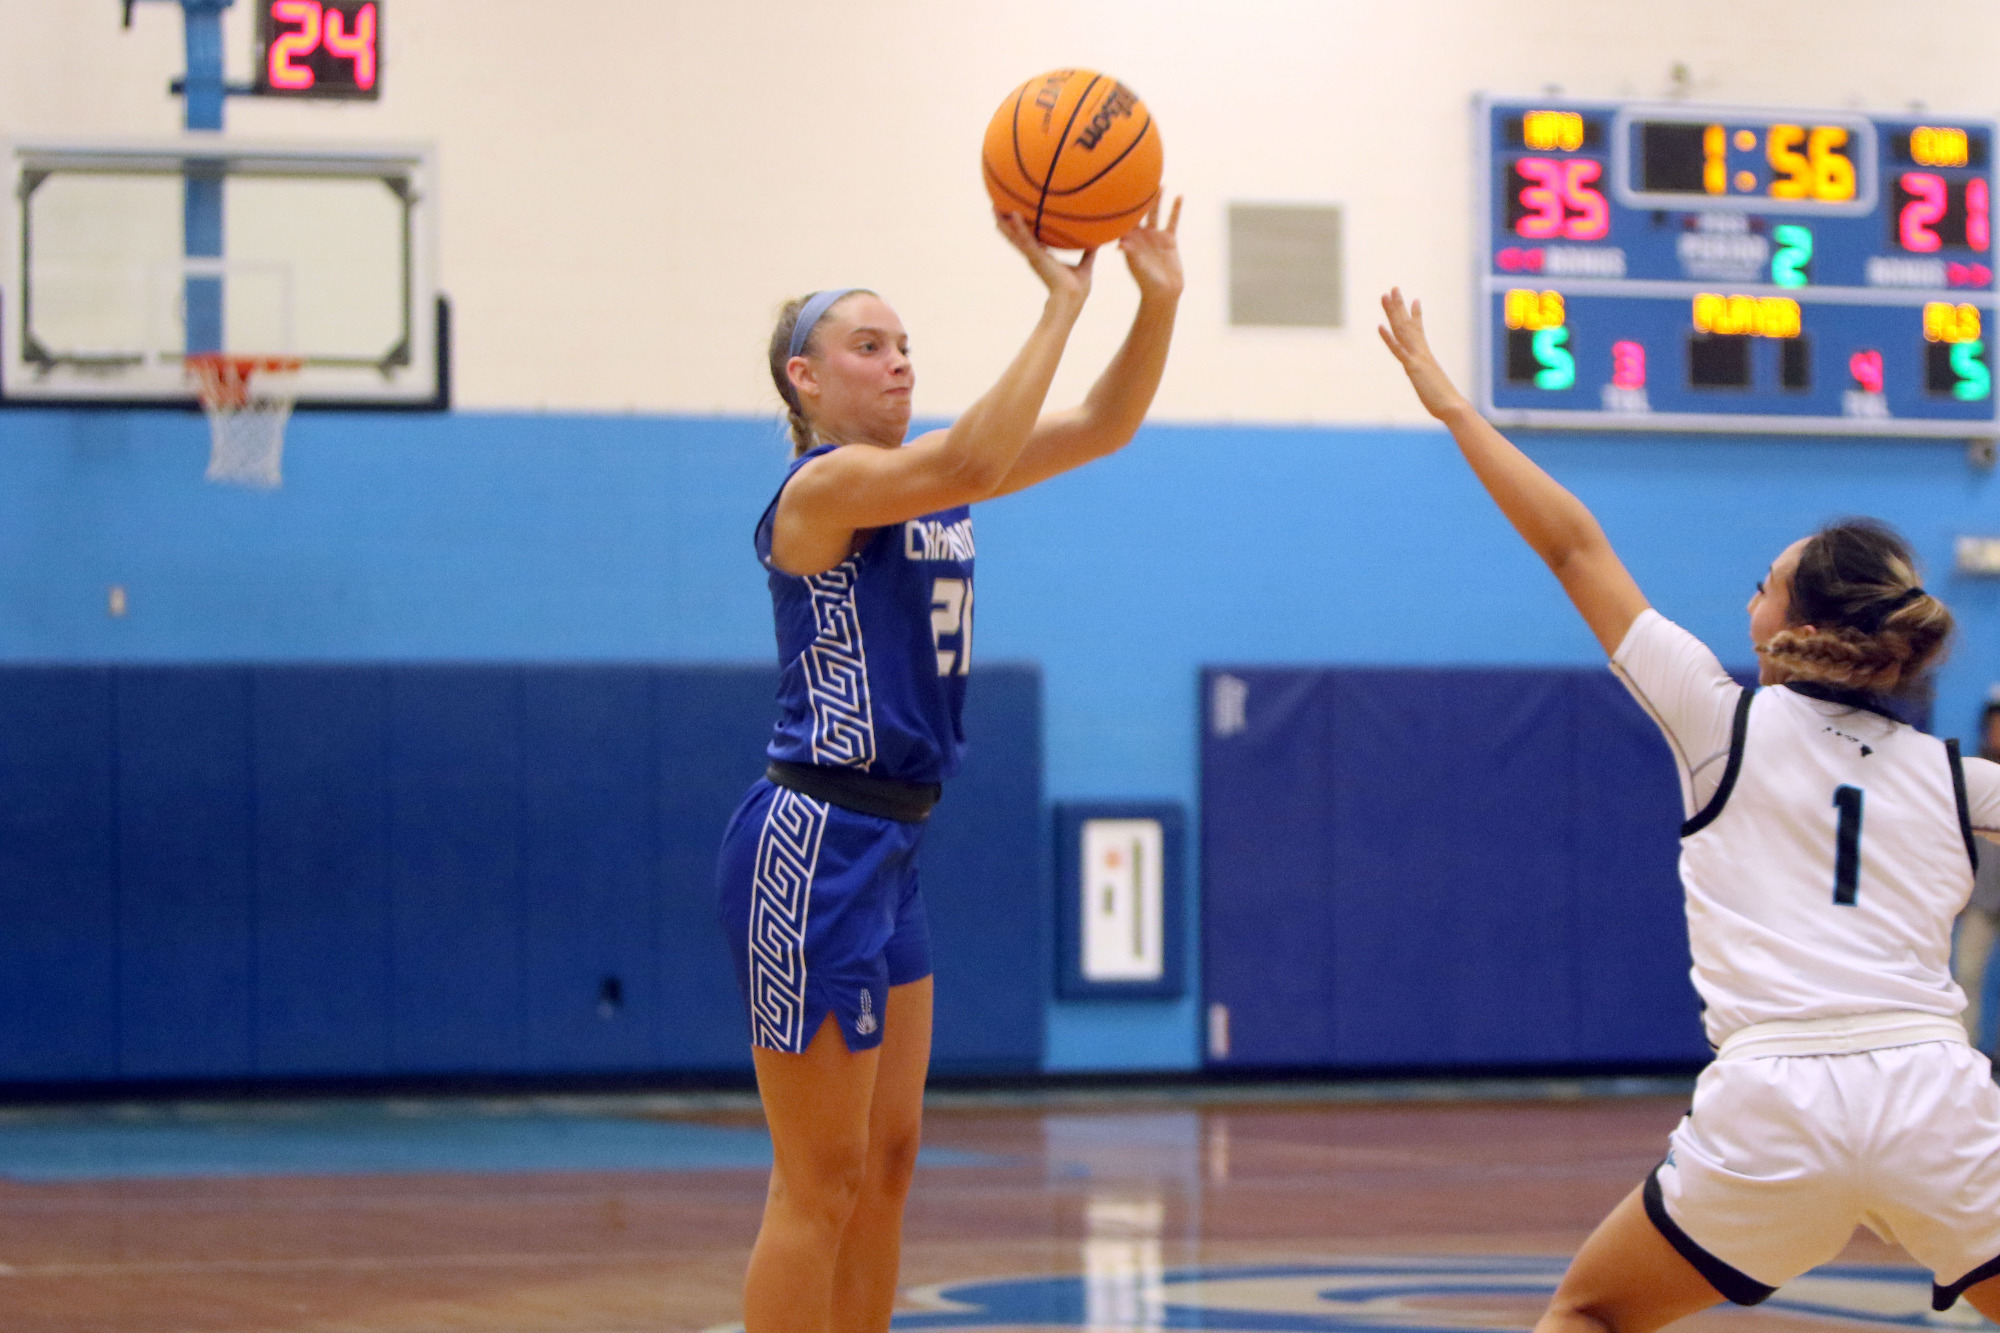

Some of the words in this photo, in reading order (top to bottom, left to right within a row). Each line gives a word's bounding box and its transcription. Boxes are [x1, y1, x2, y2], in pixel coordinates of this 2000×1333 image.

[269, 0, 376, 90] 24
[1515, 157, 1610, 240] 35
[1703, 123, 1857, 203] 1:56
[1899, 172, 1990, 252] 21
[1772, 225, 1813, 289] 2
[1532, 326, 1575, 390] 5
[1611, 340, 1646, 390] 3
[1950, 341, 1991, 400] 5
[930, 577, 974, 676] 21
[1832, 783, 1865, 907] 1
